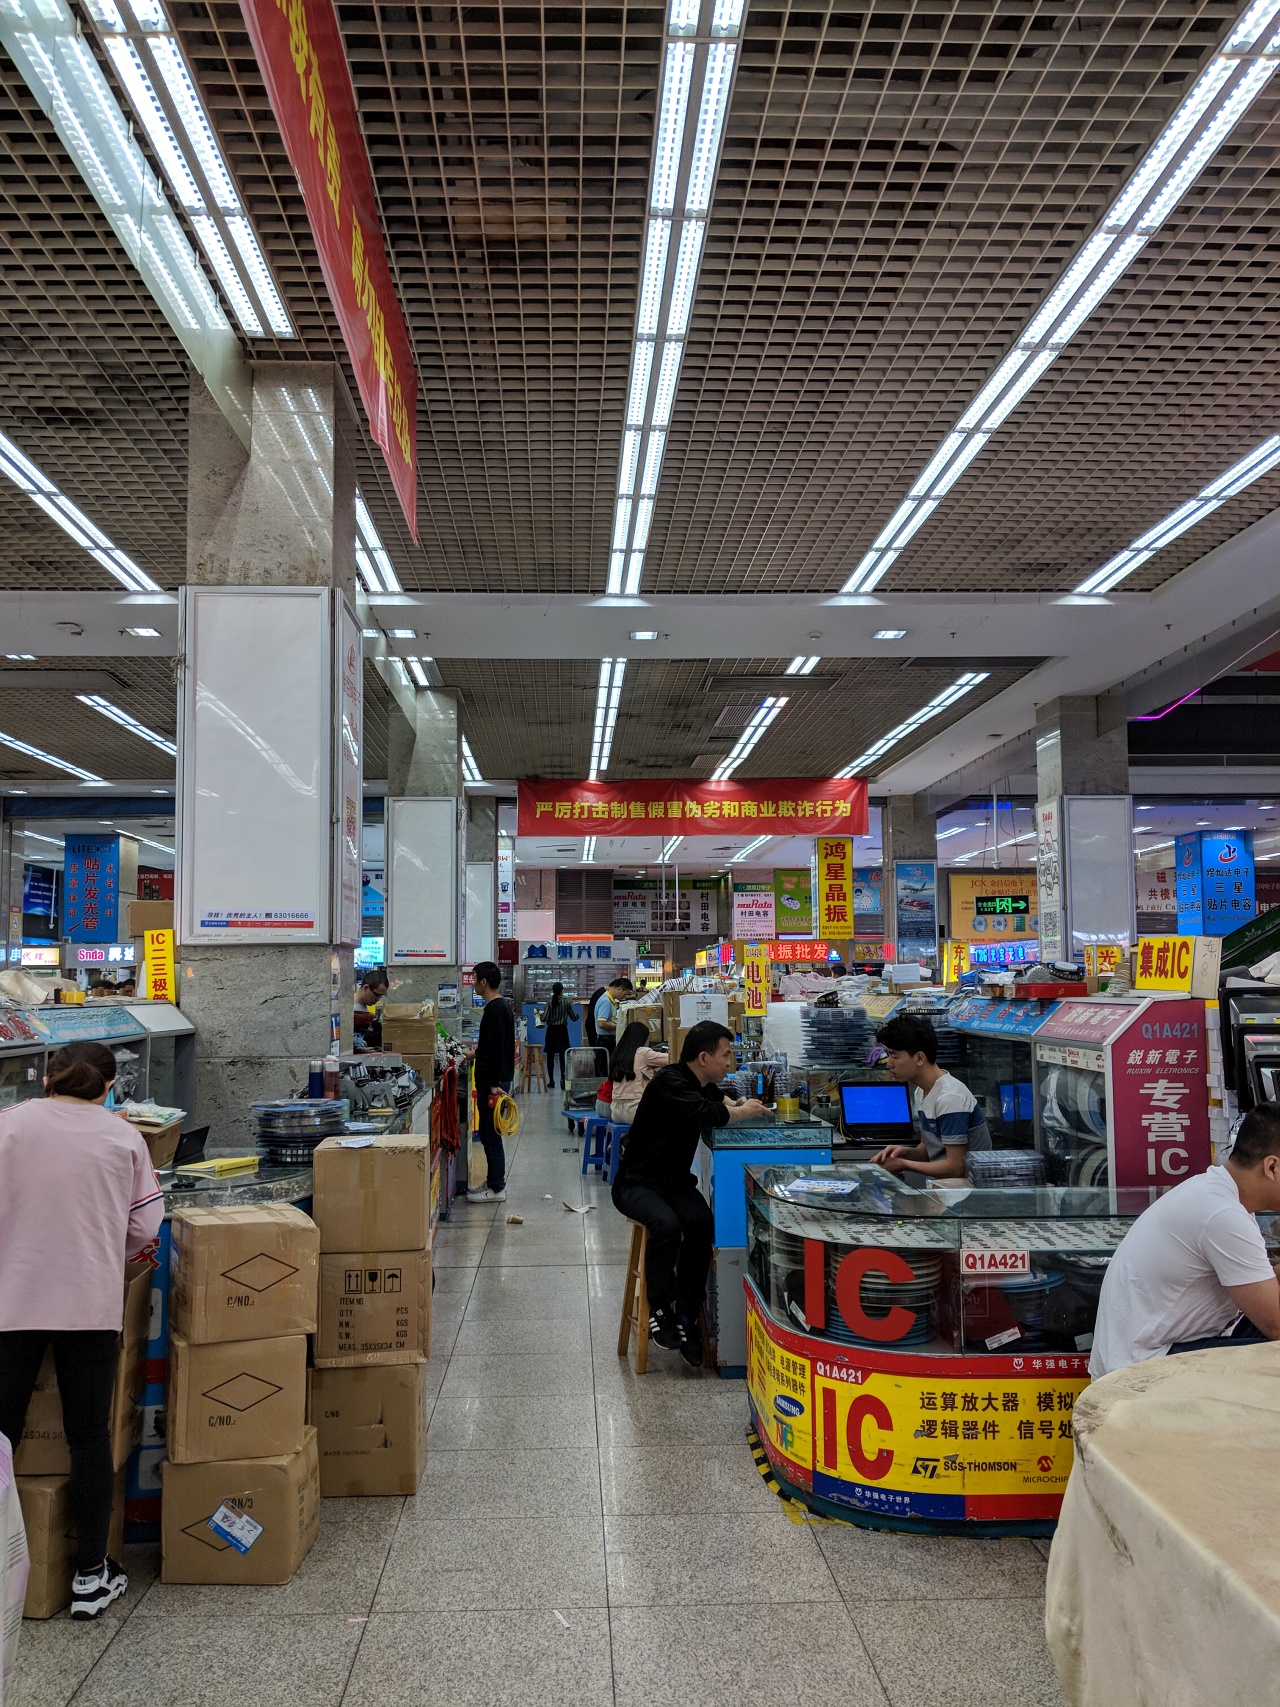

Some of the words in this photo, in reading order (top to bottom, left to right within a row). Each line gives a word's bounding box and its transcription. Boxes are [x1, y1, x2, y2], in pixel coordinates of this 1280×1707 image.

[535, 800, 852, 819] 严厉打击制售假冒伪劣和商业欺诈行为
[823, 842, 848, 923] 鸿星晶振
[970, 880, 987, 888] JCX
[1214, 882, 1245, 894] 三星
[82, 857, 101, 930] 贴片发光管
[699, 891, 710, 932] 村田电容
[736, 899, 772, 908] muRata
[1207, 898, 1252, 911] 贴片电容
[78, 948, 105, 961] Snda
[1139, 940, 1190, 979] 集成IC
[746, 960, 764, 1011] 电池
[1142, 1022, 1199, 1040] Q1A421
[964, 1252, 1027, 1270] Q1A421
[804, 1237, 917, 1341] IC
[396, 1307, 409, 1315] PCS
[396, 1318, 409, 1327] KGS
[395, 1330, 408, 1338] KGS
[395, 1341, 405, 1349] CM
[816, 1361, 863, 1384] Q1A421
[776, 1395, 801, 1416] SAMSUNG
[919, 1391, 1020, 1413] 运算放大器
[1036, 1391, 1076, 1413] 模拟
[208, 1414, 236, 1428] C/NO.:
[919, 1419, 1001, 1441] 逻辑器件
[822, 1386, 895, 1481] IC
[911, 1457, 941, 1479] ST
[943, 1461, 1018, 1473] SGS-THOMSON
[864, 1489, 911, 1504] 华强电子世界
